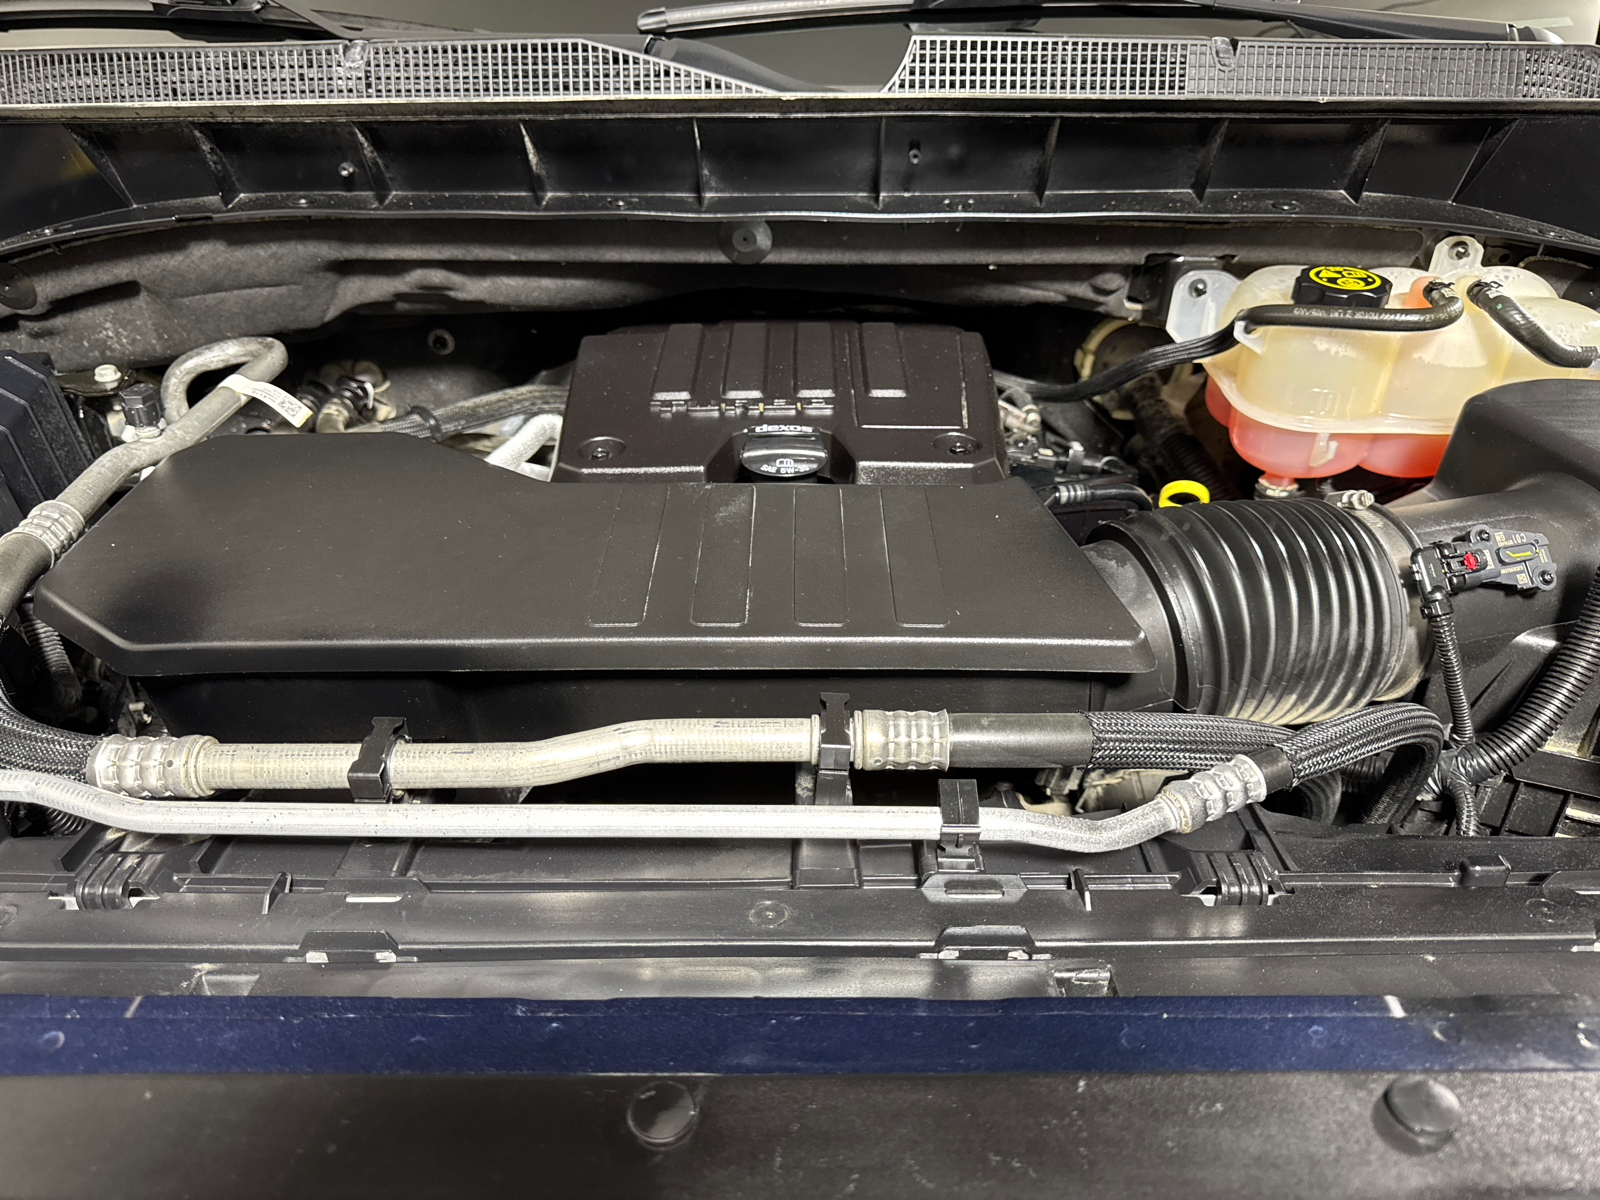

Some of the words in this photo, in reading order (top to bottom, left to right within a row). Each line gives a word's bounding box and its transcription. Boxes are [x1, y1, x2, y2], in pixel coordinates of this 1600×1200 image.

[755, 424, 813, 433] dexos
[760, 464, 777, 473] SAE
[780, 464, 810, 474] 5W-30
